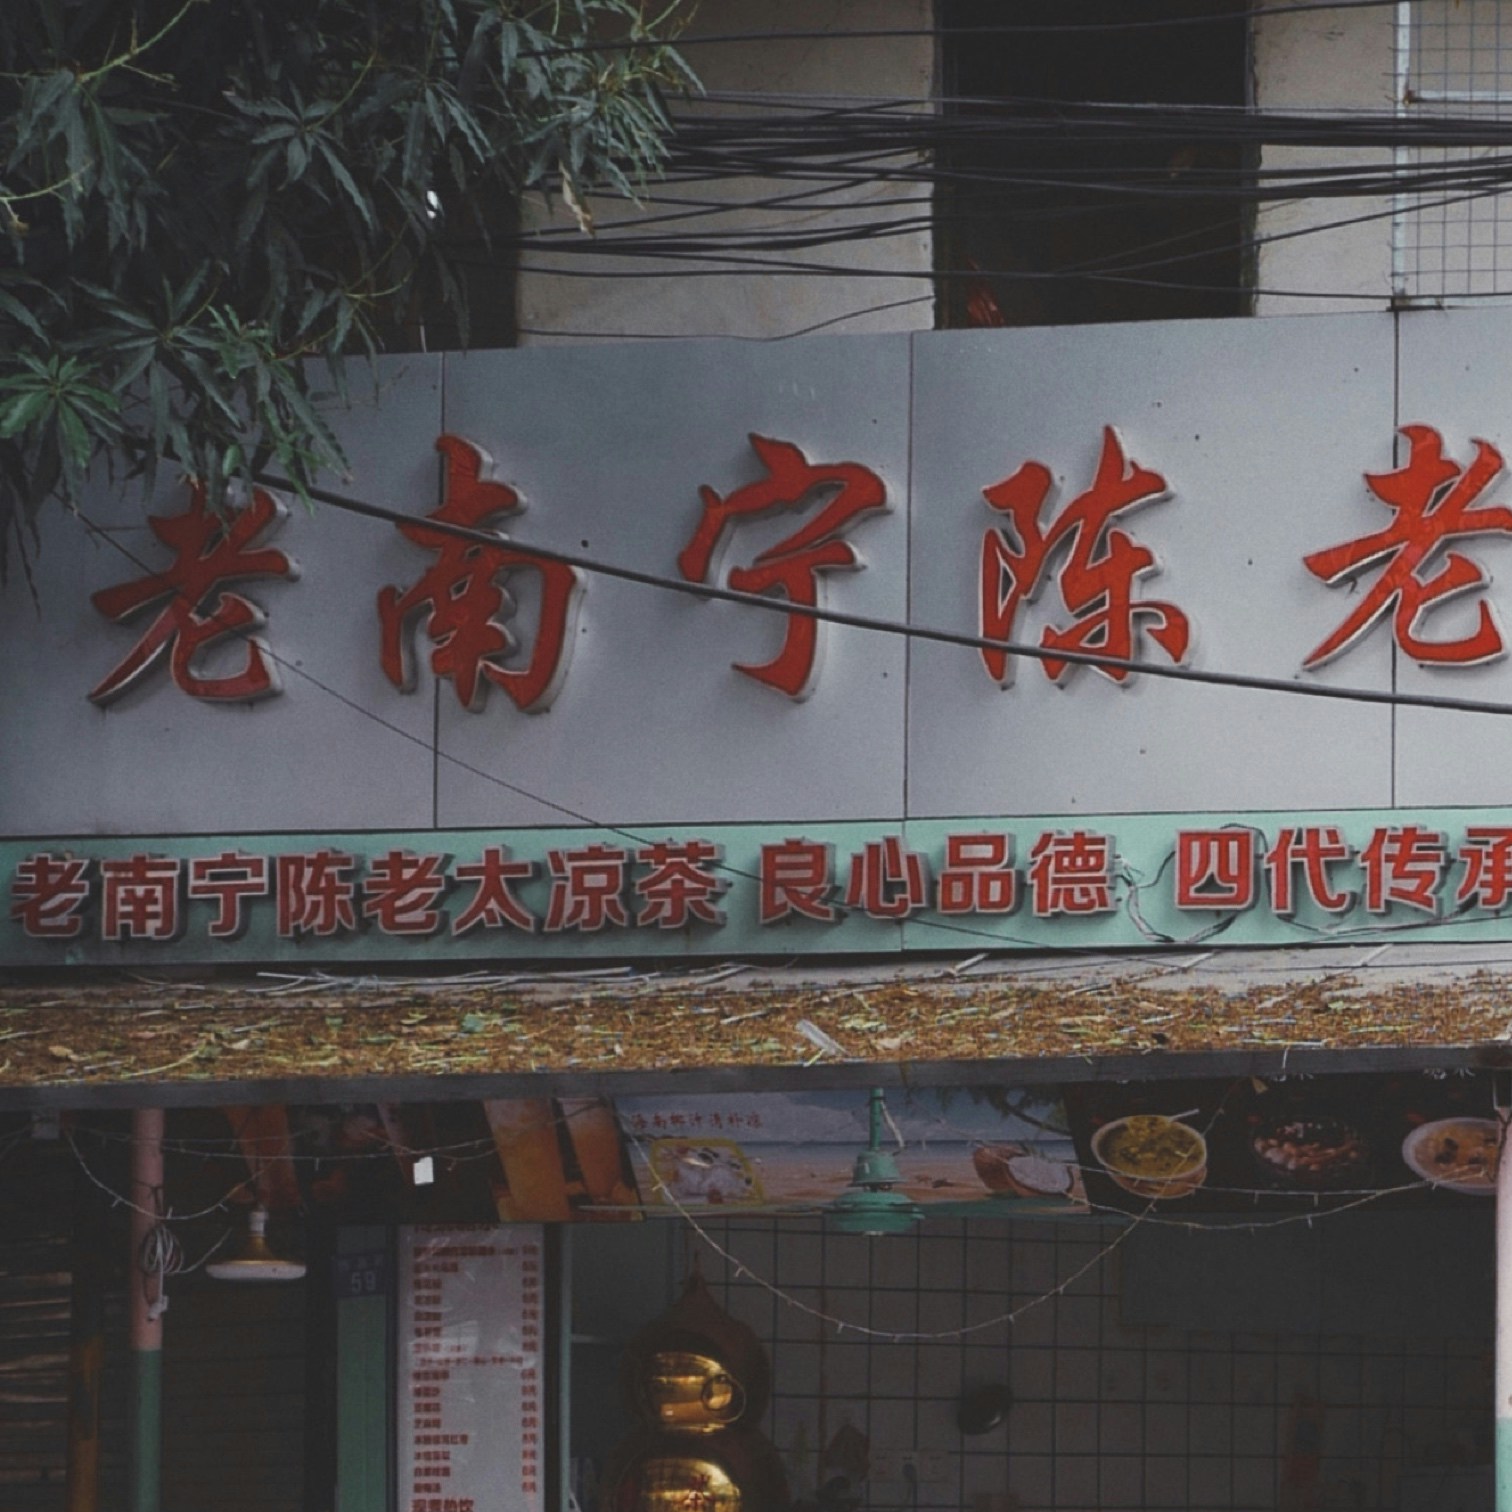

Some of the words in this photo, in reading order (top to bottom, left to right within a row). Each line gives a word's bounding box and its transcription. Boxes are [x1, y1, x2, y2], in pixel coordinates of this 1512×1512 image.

[11, 840, 725, 939] 老南宁陈老太凉茶
[759, 828, 1117, 927] 良心品德
